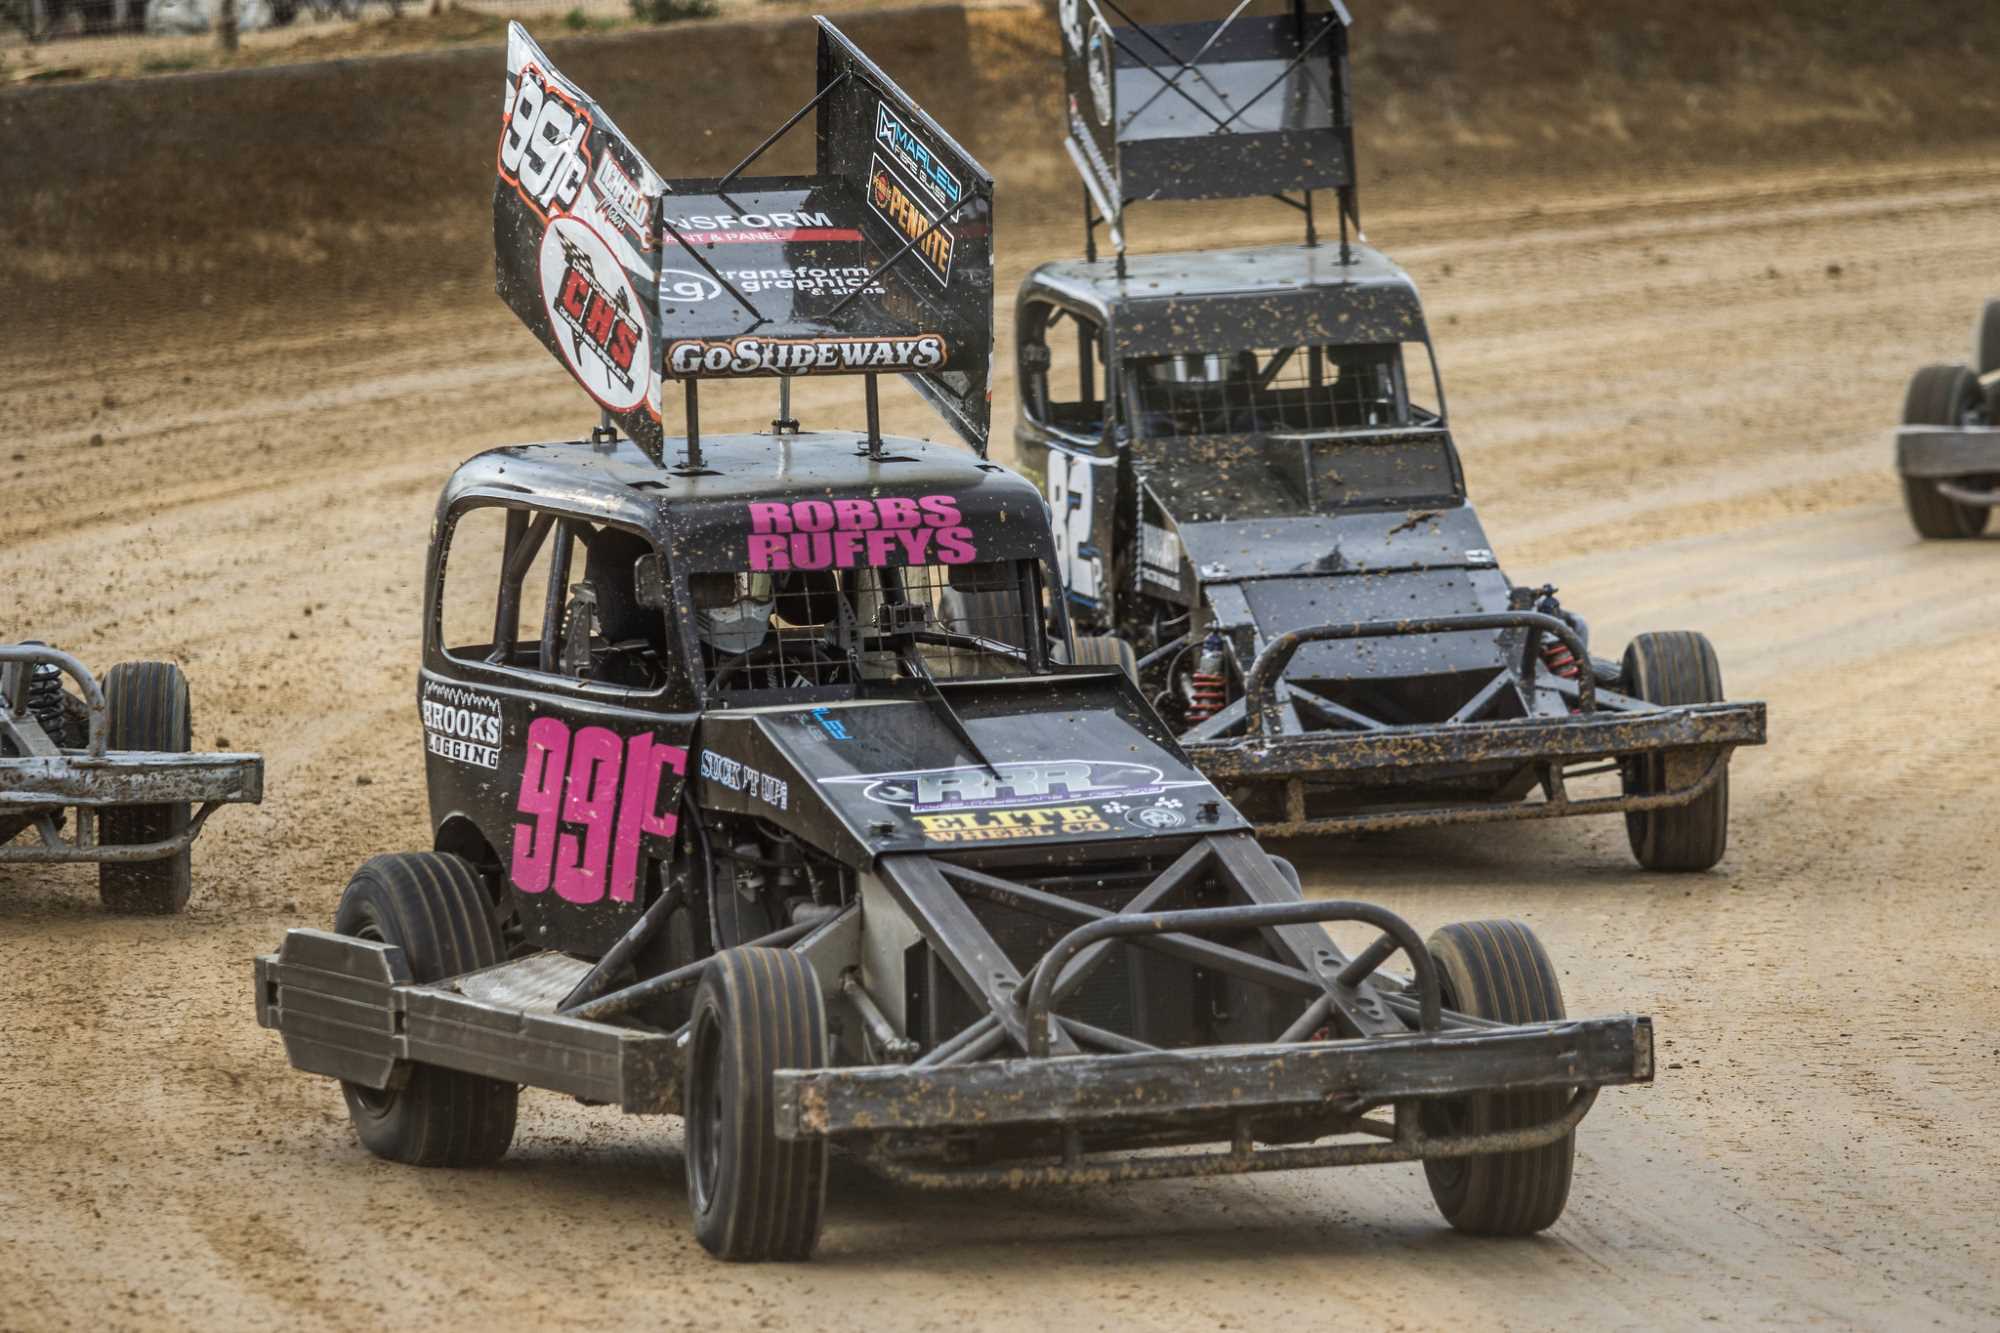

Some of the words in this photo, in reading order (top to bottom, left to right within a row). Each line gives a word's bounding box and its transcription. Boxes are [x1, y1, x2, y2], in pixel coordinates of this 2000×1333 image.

[726, 231, 787, 243] PANEL
[889, 186, 948, 273] PENRITE
[748, 495, 963, 533] ROBBS
[747, 527, 977, 571] RUFFYS
[422, 699, 500, 744] BROOKS
[701, 749, 741, 791] SUCK
[912, 806, 1101, 833] ELITE
[925, 825, 1056, 842] WHEEL
